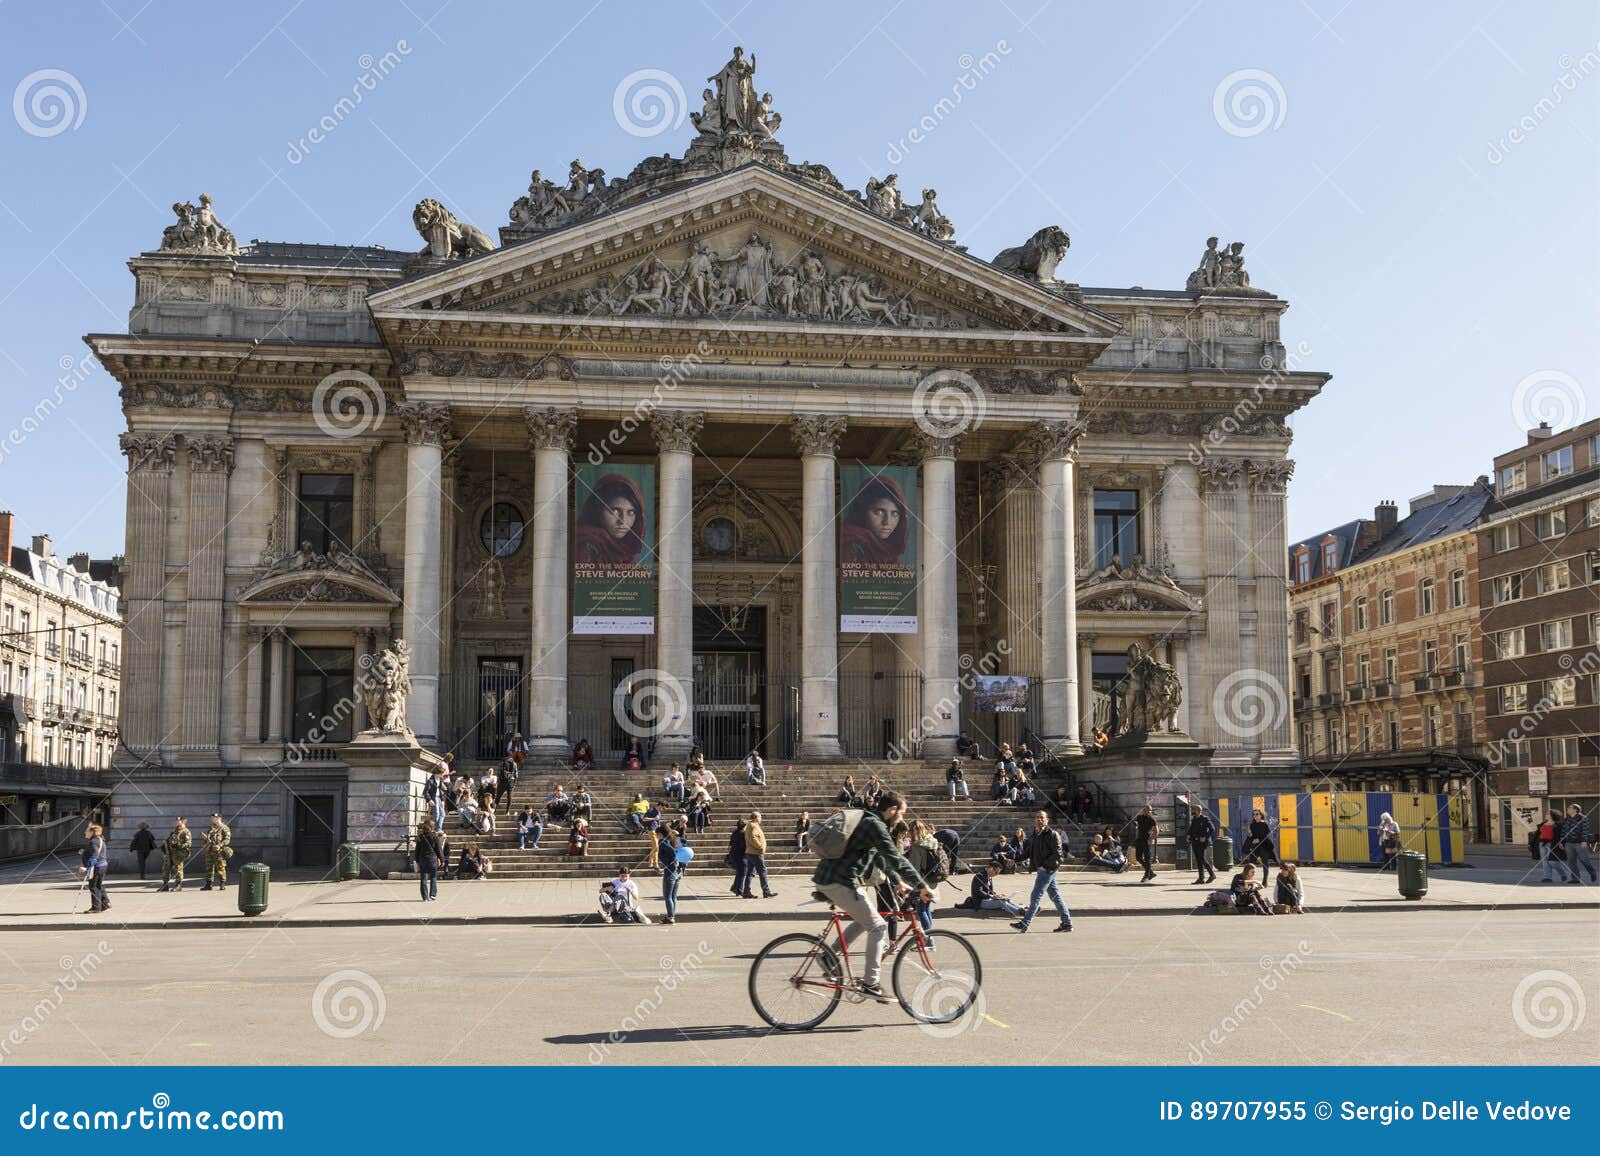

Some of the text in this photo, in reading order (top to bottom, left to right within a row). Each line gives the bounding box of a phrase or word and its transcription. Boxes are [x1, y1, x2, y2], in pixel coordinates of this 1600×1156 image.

[575, 570, 653, 578] STEVE McCURRY
[842, 570, 916, 579] STEVE McCURRY
